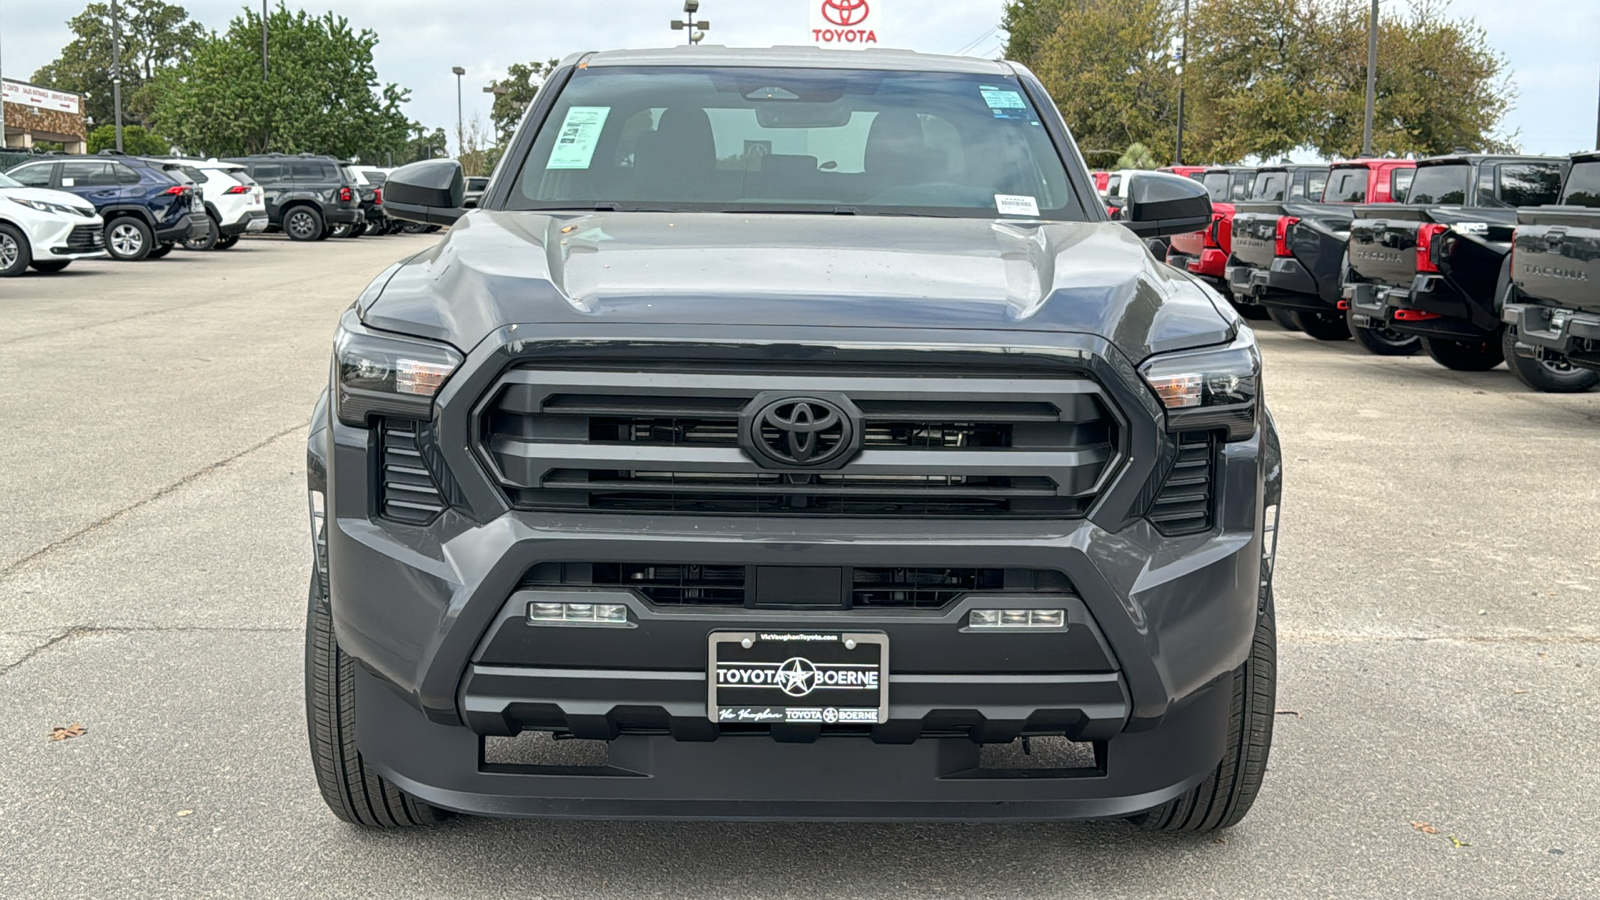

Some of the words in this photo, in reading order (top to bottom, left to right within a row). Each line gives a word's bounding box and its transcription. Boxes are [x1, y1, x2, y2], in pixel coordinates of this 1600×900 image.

[812, 29, 877, 43] TOYOTA
[1356, 251, 1403, 263] TACOMA
[1522, 263, 1589, 281] TACOMA
[760, 633, 838, 642] VicVaughanToyota.com
[717, 669, 787, 683] TOYOTA
[815, 671, 878, 685] BOERNE
[738, 708, 783, 721] Vaughan
[785, 711, 822, 719] TOYOTA
